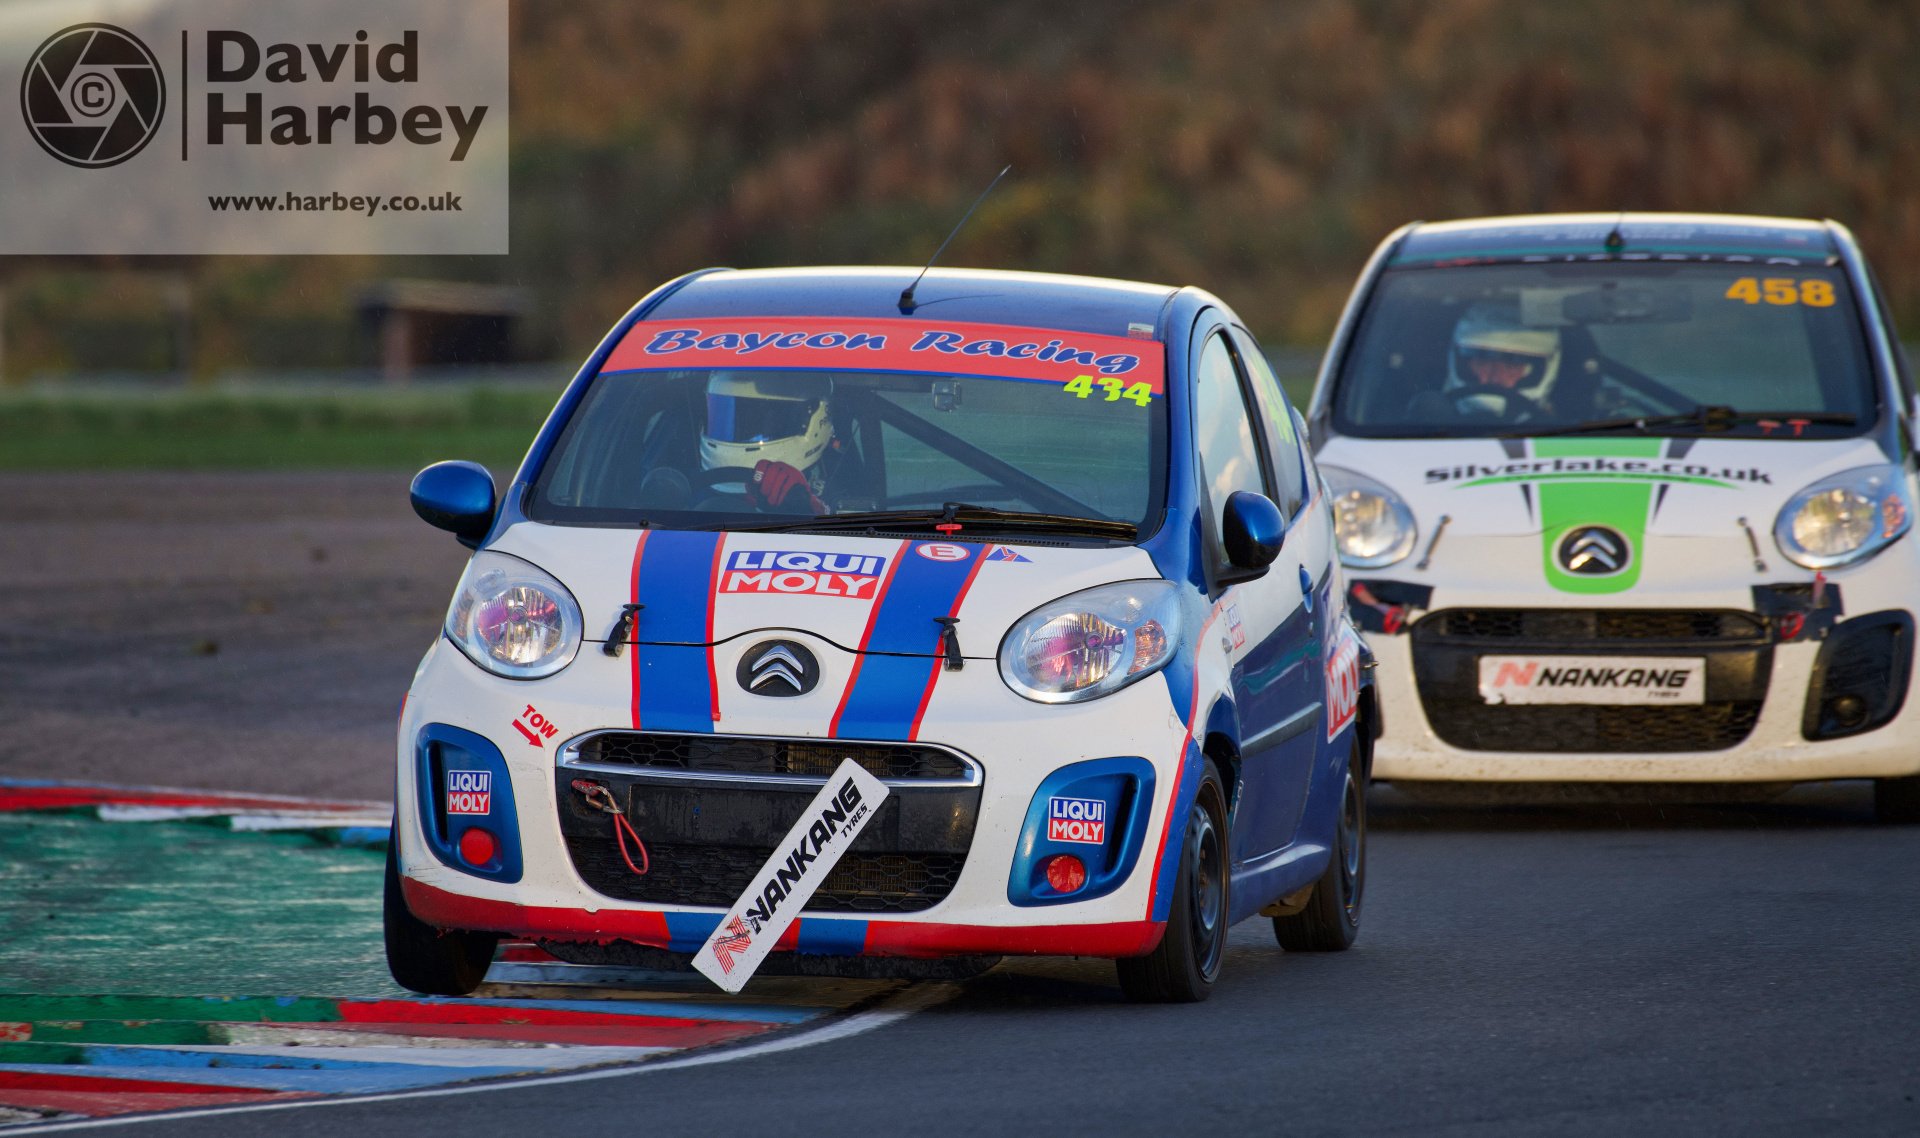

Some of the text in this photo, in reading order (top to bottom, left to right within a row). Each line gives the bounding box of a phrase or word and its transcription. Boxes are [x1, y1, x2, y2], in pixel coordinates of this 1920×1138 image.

[1725, 277, 1836, 307] 458
[643, 328, 887, 355] Baycon
[911, 329, 1140, 375] Racing
[1063, 374, 1153, 407] 434
[1424, 459, 1774, 486] Silverlake.co.uk
[734, 552, 878, 575] LIQUI
[726, 572, 877, 596] MOLY
[1537, 668, 1691, 688] NANKANG
[522, 704, 559, 739] TOW
[449, 773, 488, 792] LIQUI
[448, 793, 488, 812] MOLY
[1053, 800, 1102, 820] LIQUI
[840, 802, 868, 839] TYRES
[1052, 820, 1102, 841] MOLY
[745, 776, 863, 935] NANKANG
